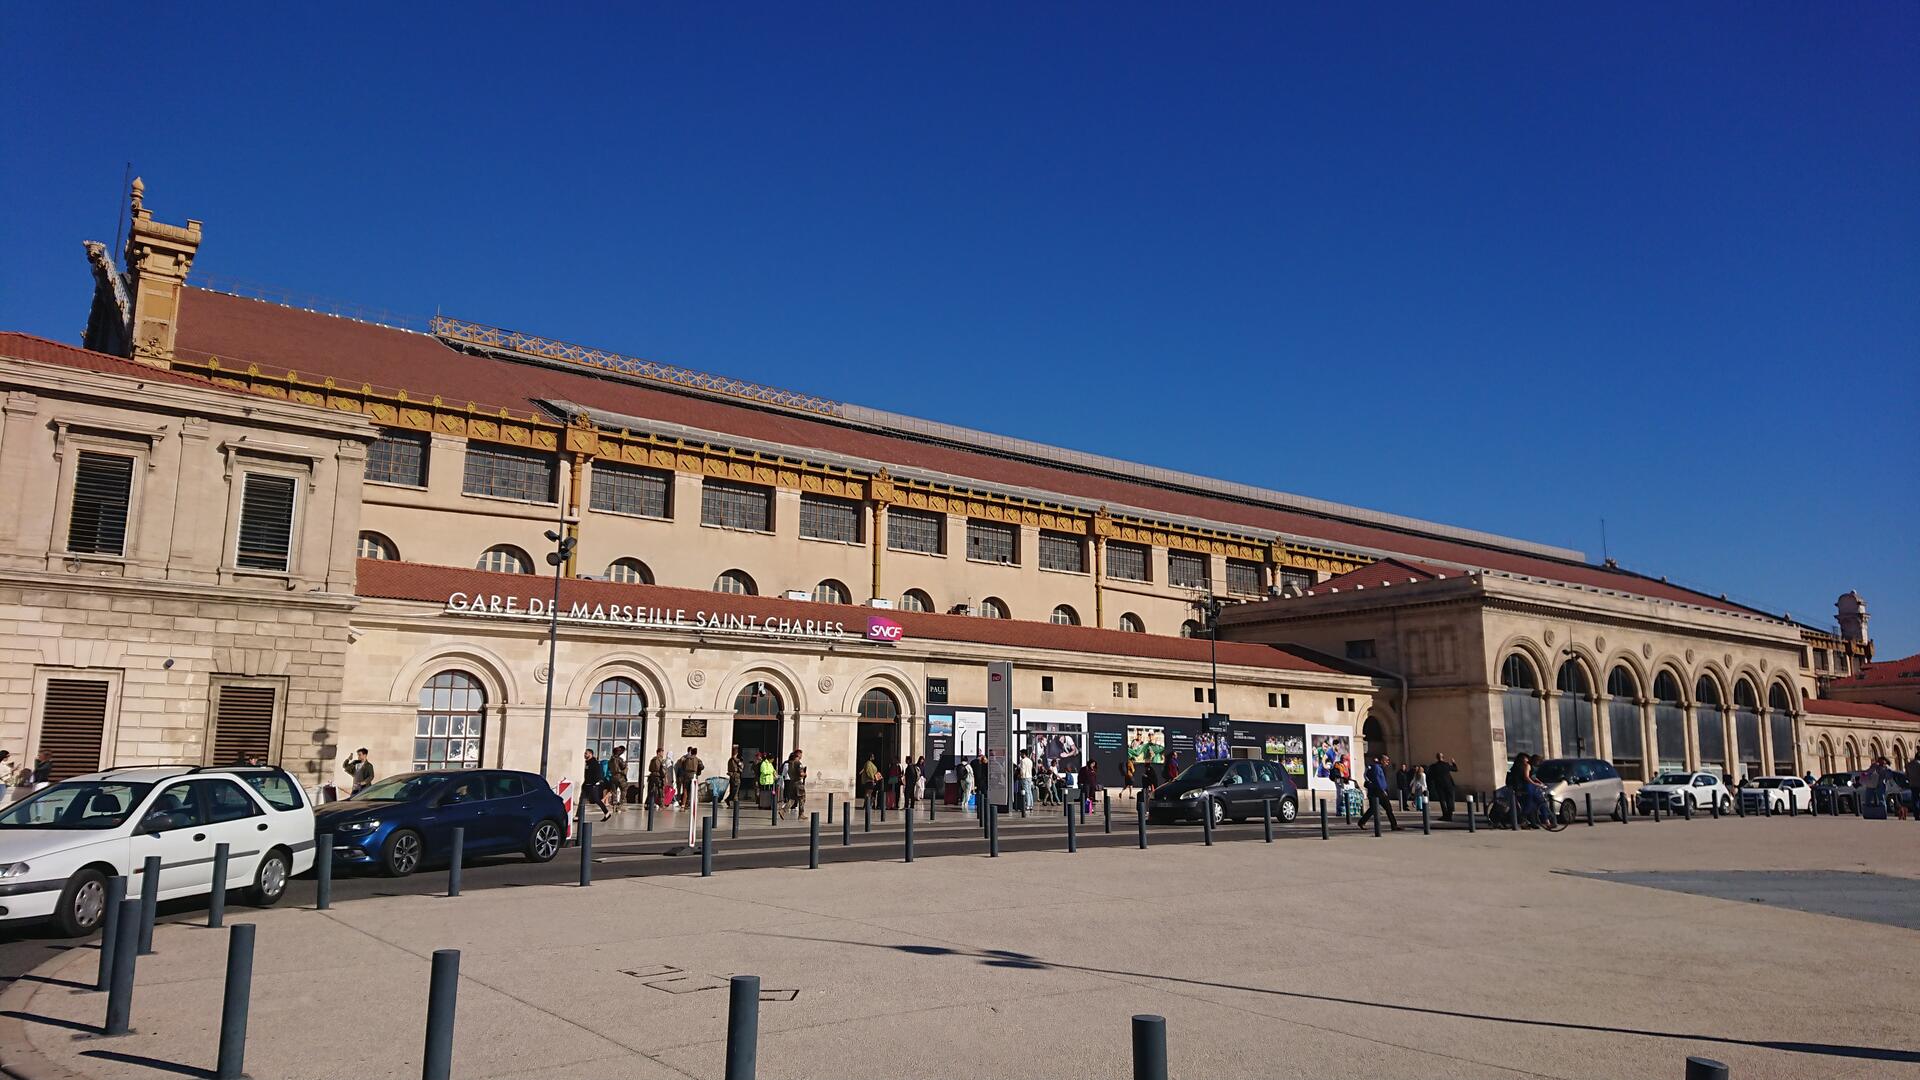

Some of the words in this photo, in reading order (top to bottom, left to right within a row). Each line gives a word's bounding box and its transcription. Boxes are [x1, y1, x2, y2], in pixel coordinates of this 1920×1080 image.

[449, 592, 518, 614] GARE
[570, 601, 686, 625] MARSEILLE
[696, 611, 757, 631] SAINT
[765, 616, 844, 637] CHARLES
[870, 624, 902, 638] SNCF
